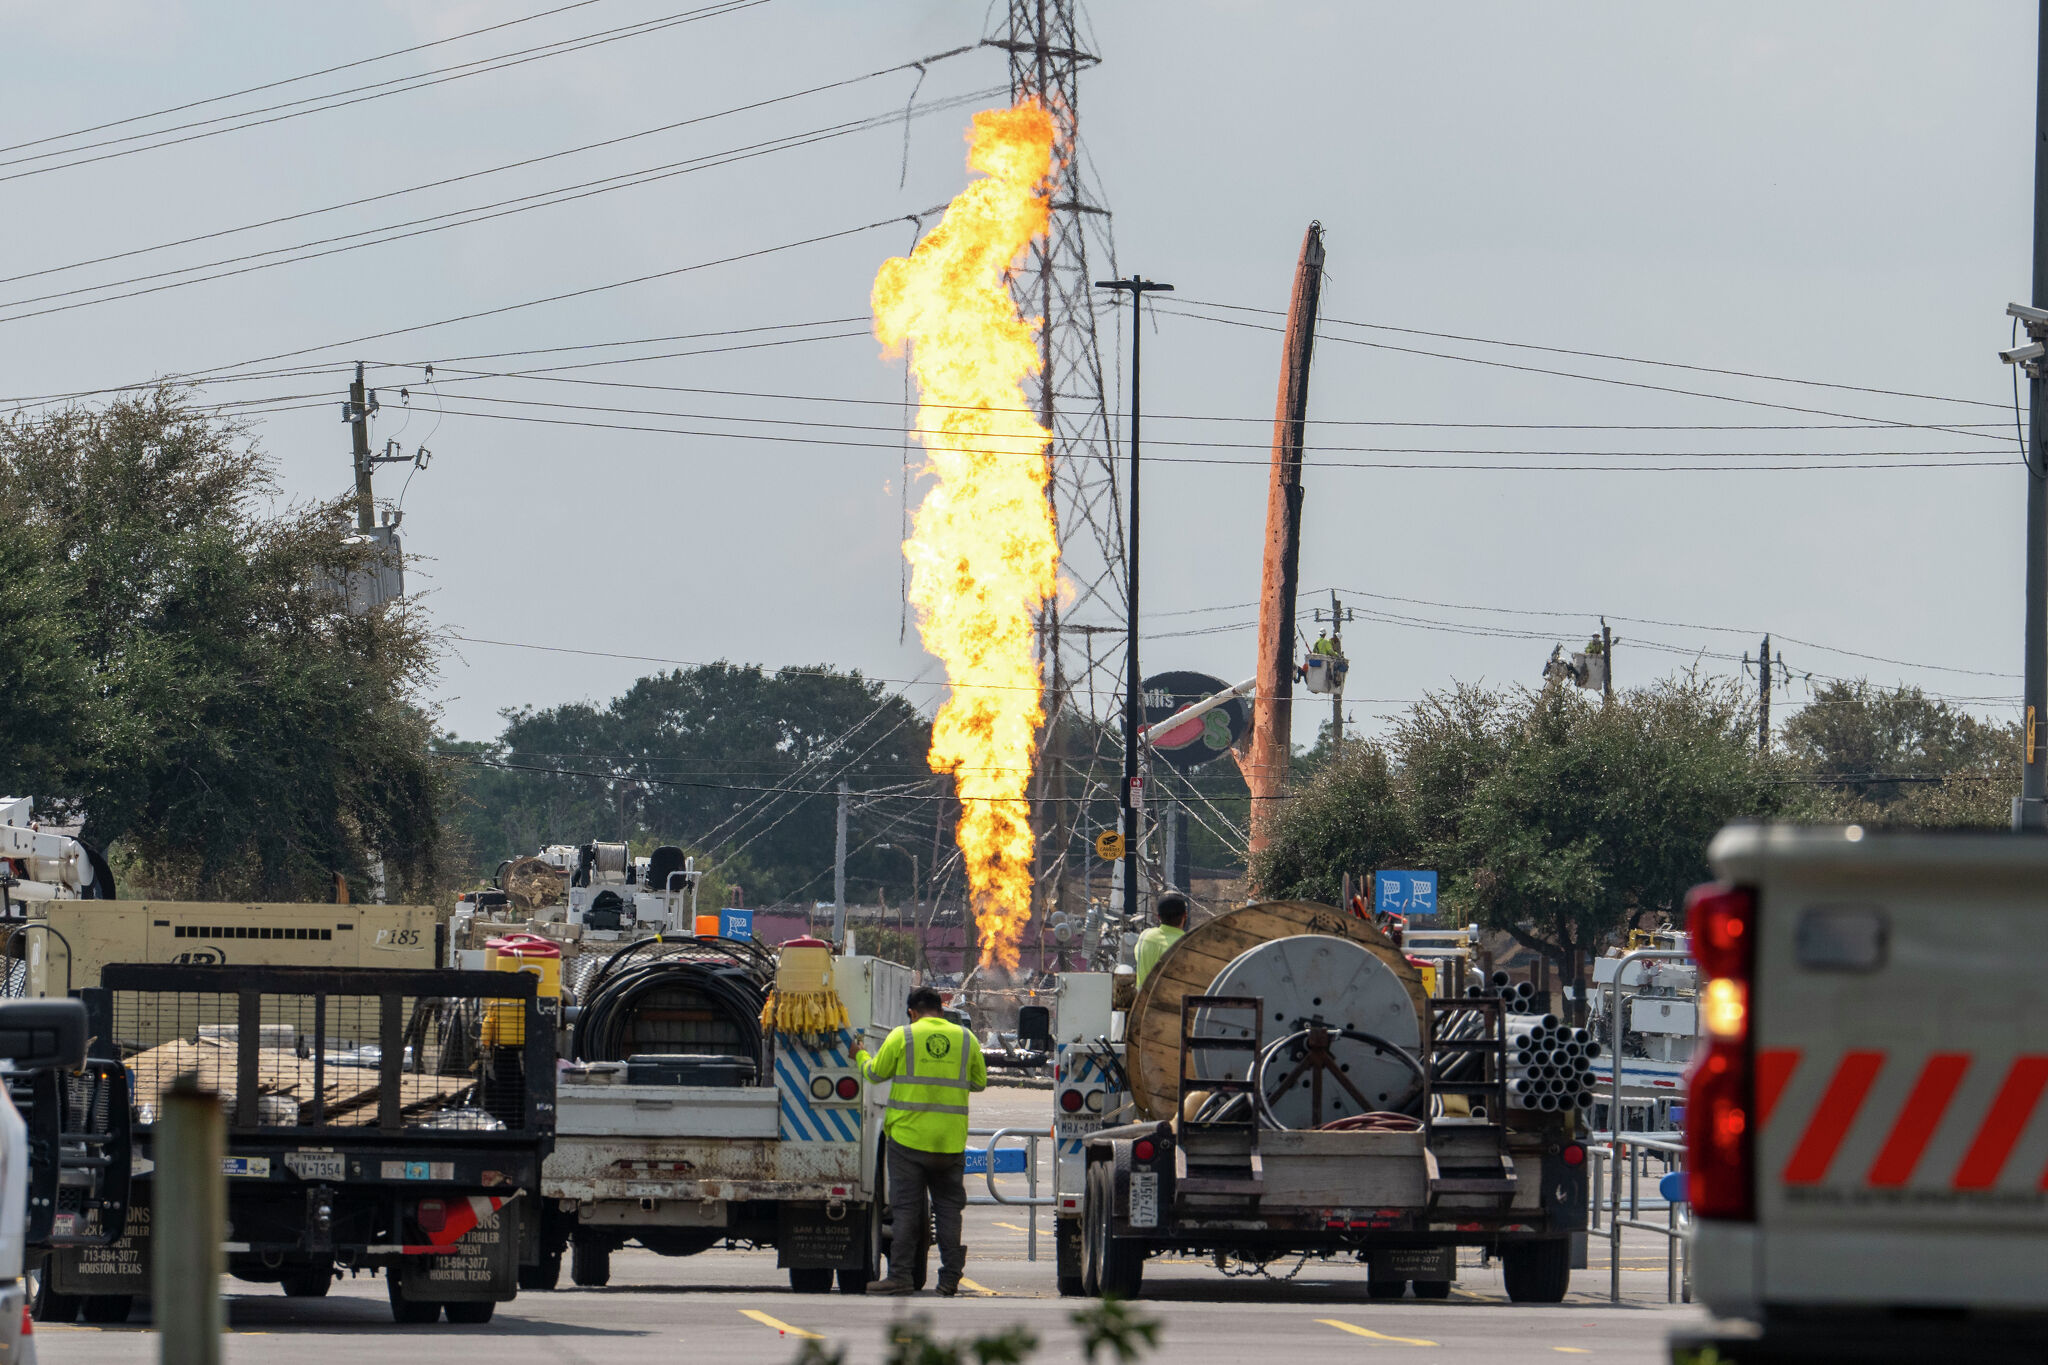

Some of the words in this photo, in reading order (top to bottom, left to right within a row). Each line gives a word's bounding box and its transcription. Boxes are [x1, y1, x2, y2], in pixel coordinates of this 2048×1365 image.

[127, 1206, 151, 1224] ONS
[124, 1225, 150, 1237] AILER
[83, 1249, 139, 1262] 713-694-3077
[118, 1262, 142, 1274] TEXAS
[467, 1269, 492, 1281] TEXAS
